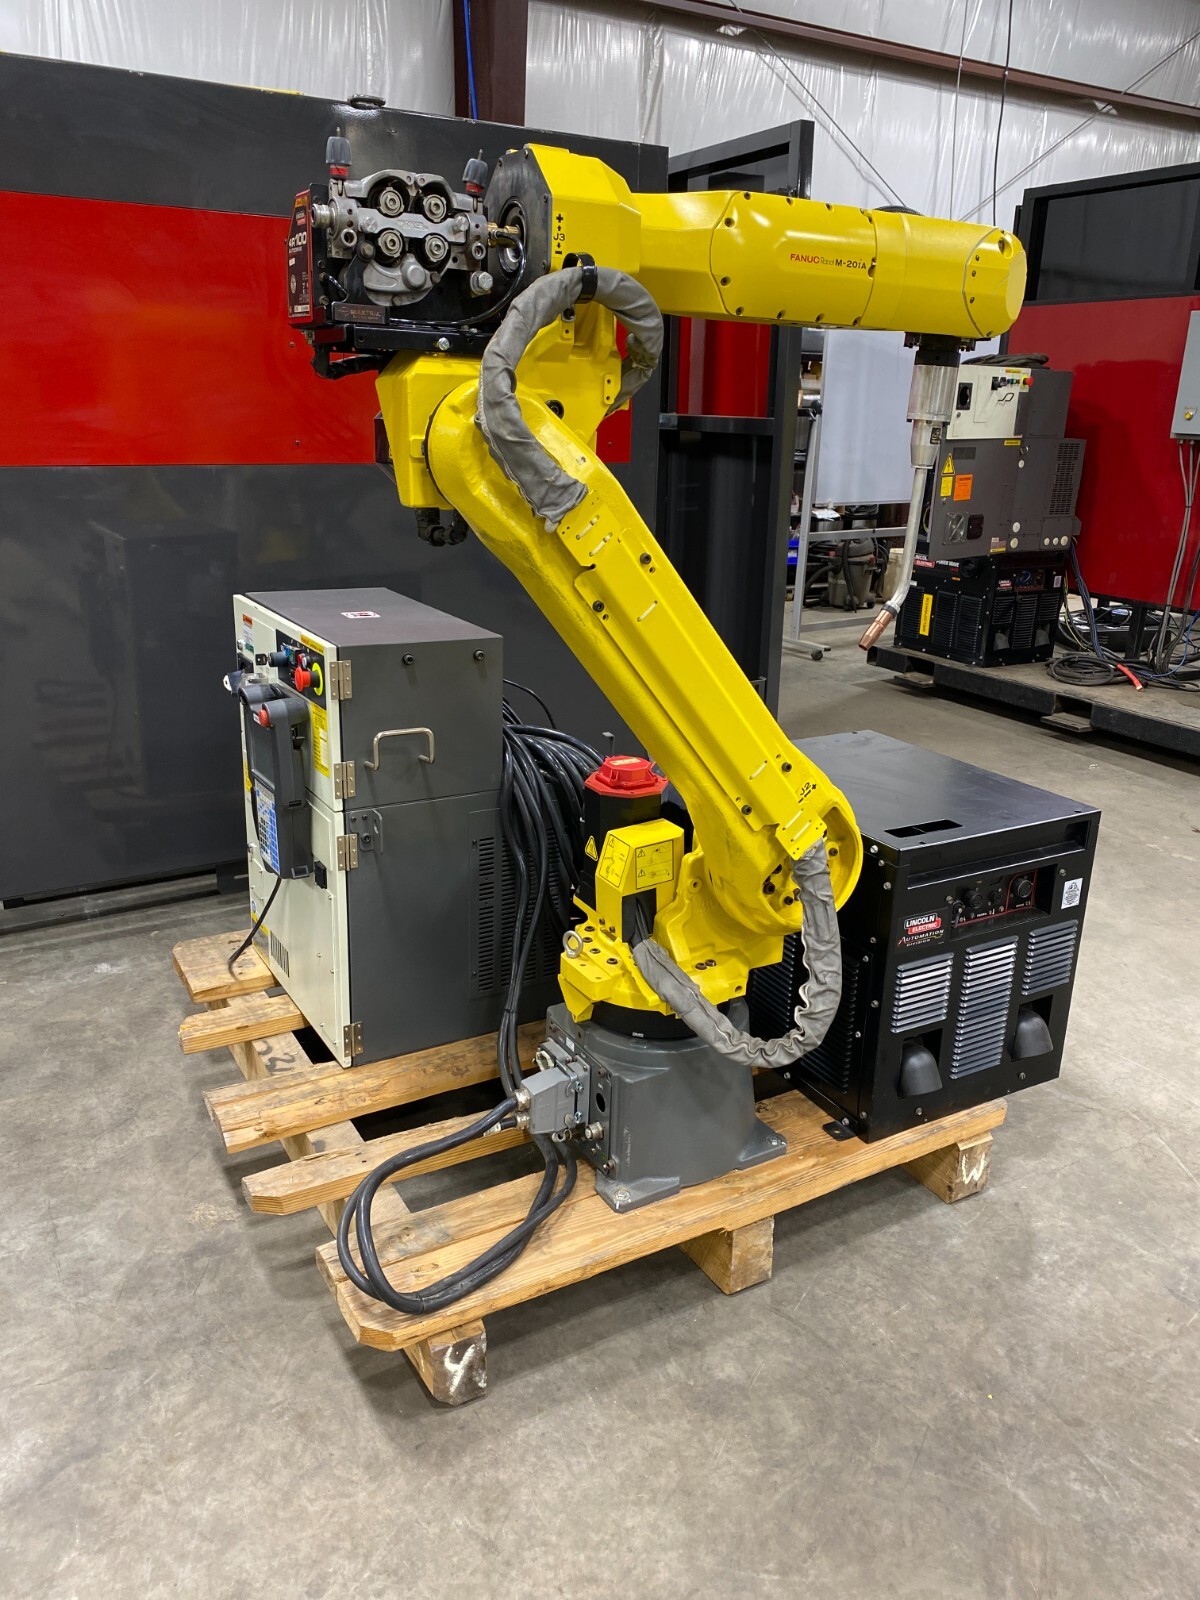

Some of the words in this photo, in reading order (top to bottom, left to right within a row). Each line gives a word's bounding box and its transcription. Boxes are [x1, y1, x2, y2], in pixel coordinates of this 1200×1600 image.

[553, 233, 566, 241] J3
[790, 253, 820, 264] FANUC
[800, 782, 811, 796] J2
[906, 915, 936, 928] LINCOLN
[912, 922, 938, 932] ELECTRIC
[898, 929, 945, 945] AUTOMATION
